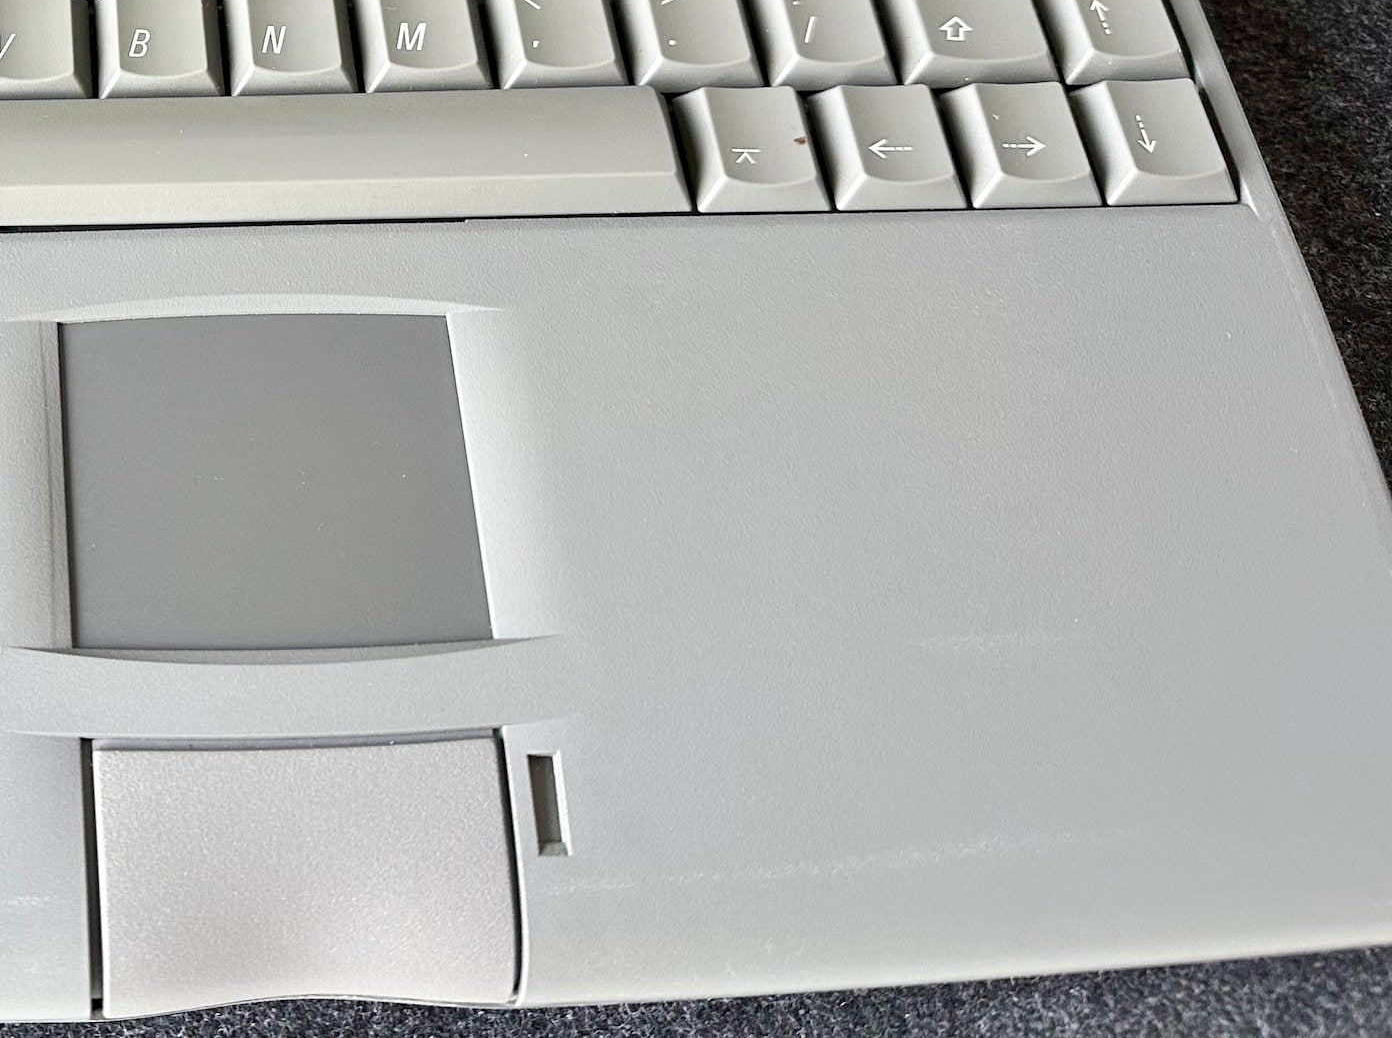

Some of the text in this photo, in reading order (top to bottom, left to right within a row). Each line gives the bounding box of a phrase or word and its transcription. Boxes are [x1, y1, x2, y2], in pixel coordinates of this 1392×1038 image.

[129, 29, 150, 57] B
[262, 26, 286, 53] N
[397, 23, 426, 50] M
